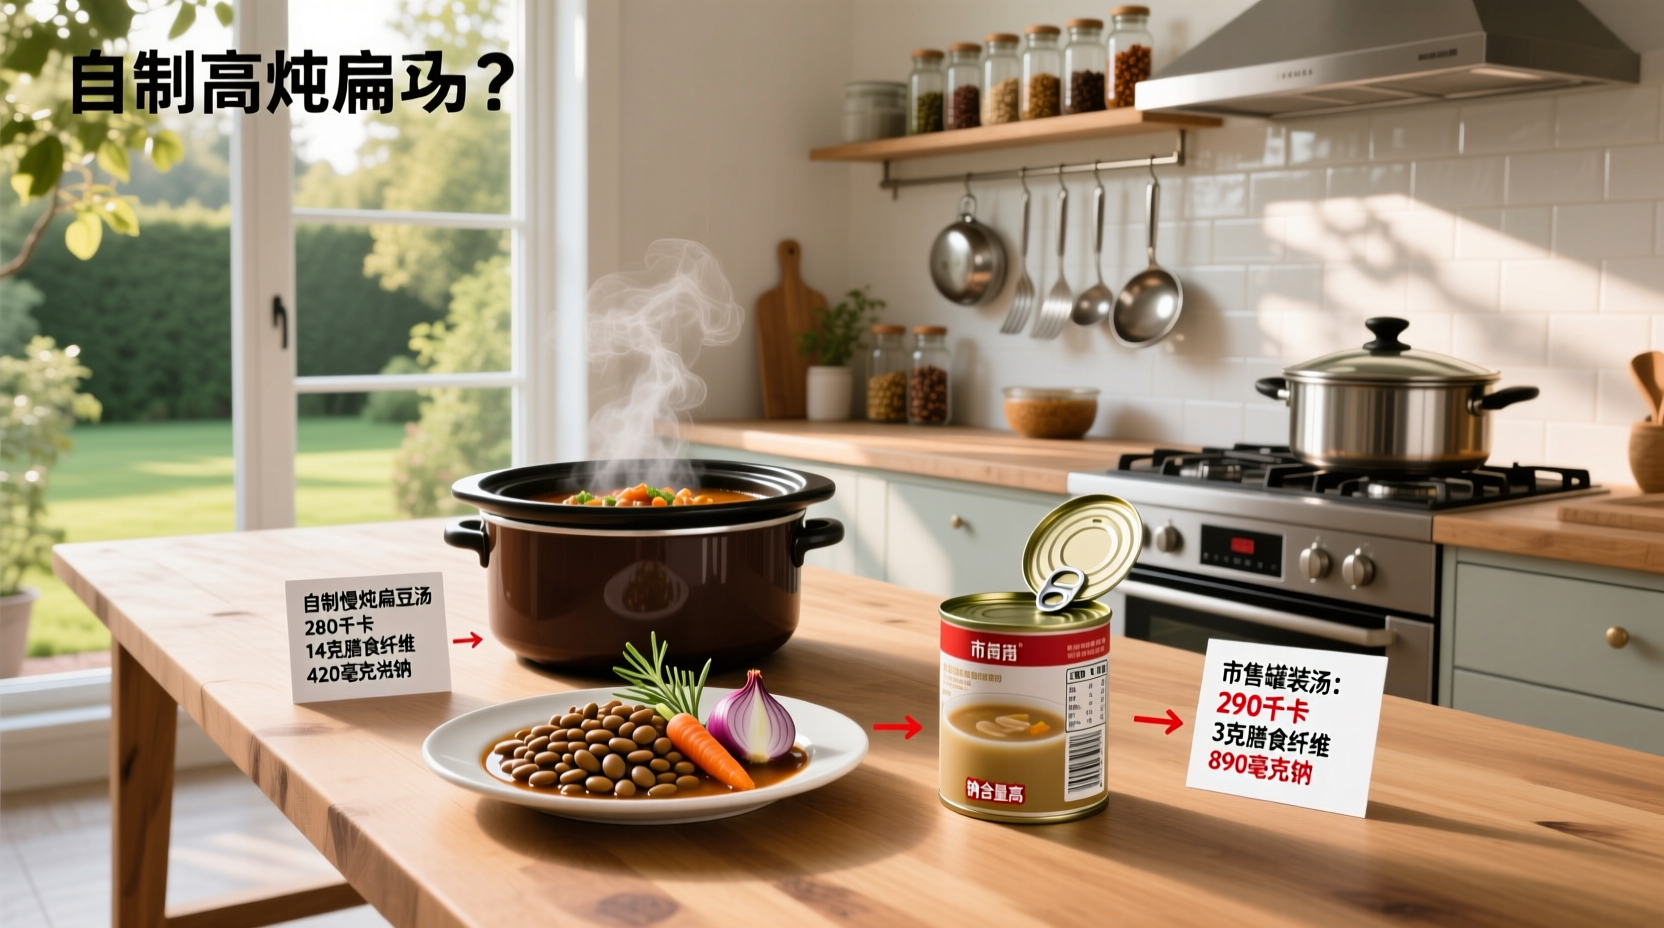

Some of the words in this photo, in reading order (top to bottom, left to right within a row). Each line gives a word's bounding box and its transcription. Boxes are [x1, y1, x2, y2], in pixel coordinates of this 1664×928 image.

[304, 586, 432, 613] 自制慢炖扁豆汤
[305, 614, 374, 636] 280千卡
[1216, 691, 1310, 724] 290千卡
[1211, 721, 1331, 758] 3克膳食纤维
[1208, 750, 1313, 786] 890毫克钠
